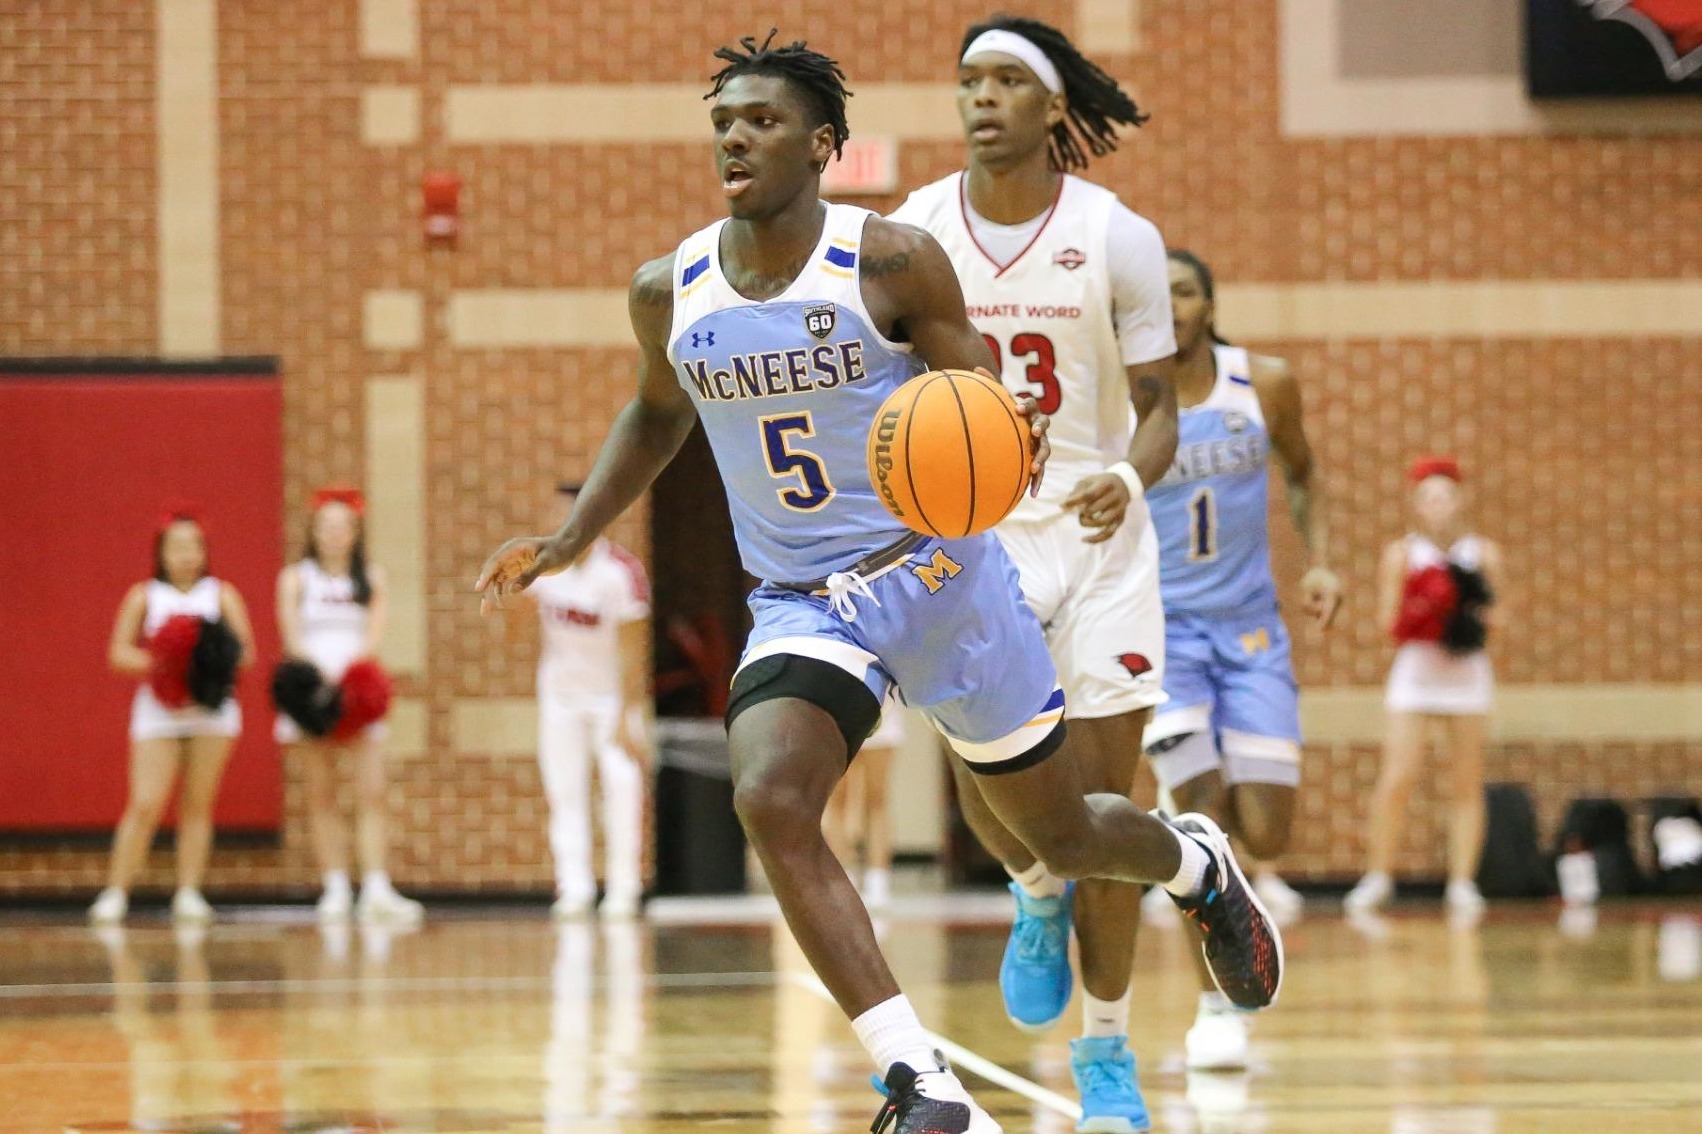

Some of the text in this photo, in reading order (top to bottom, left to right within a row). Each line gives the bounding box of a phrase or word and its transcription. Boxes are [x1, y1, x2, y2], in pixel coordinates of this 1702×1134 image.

[809, 314, 832, 331] 60
[1026, 305, 1081, 318] WORD
[681, 338, 867, 401] McNEESE
[980, 333, 1063, 416] 3
[758, 410, 836, 512] 5
[875, 409, 905, 517] Wilson
[1186, 487, 1219, 563] 1
[911, 547, 965, 595] M
